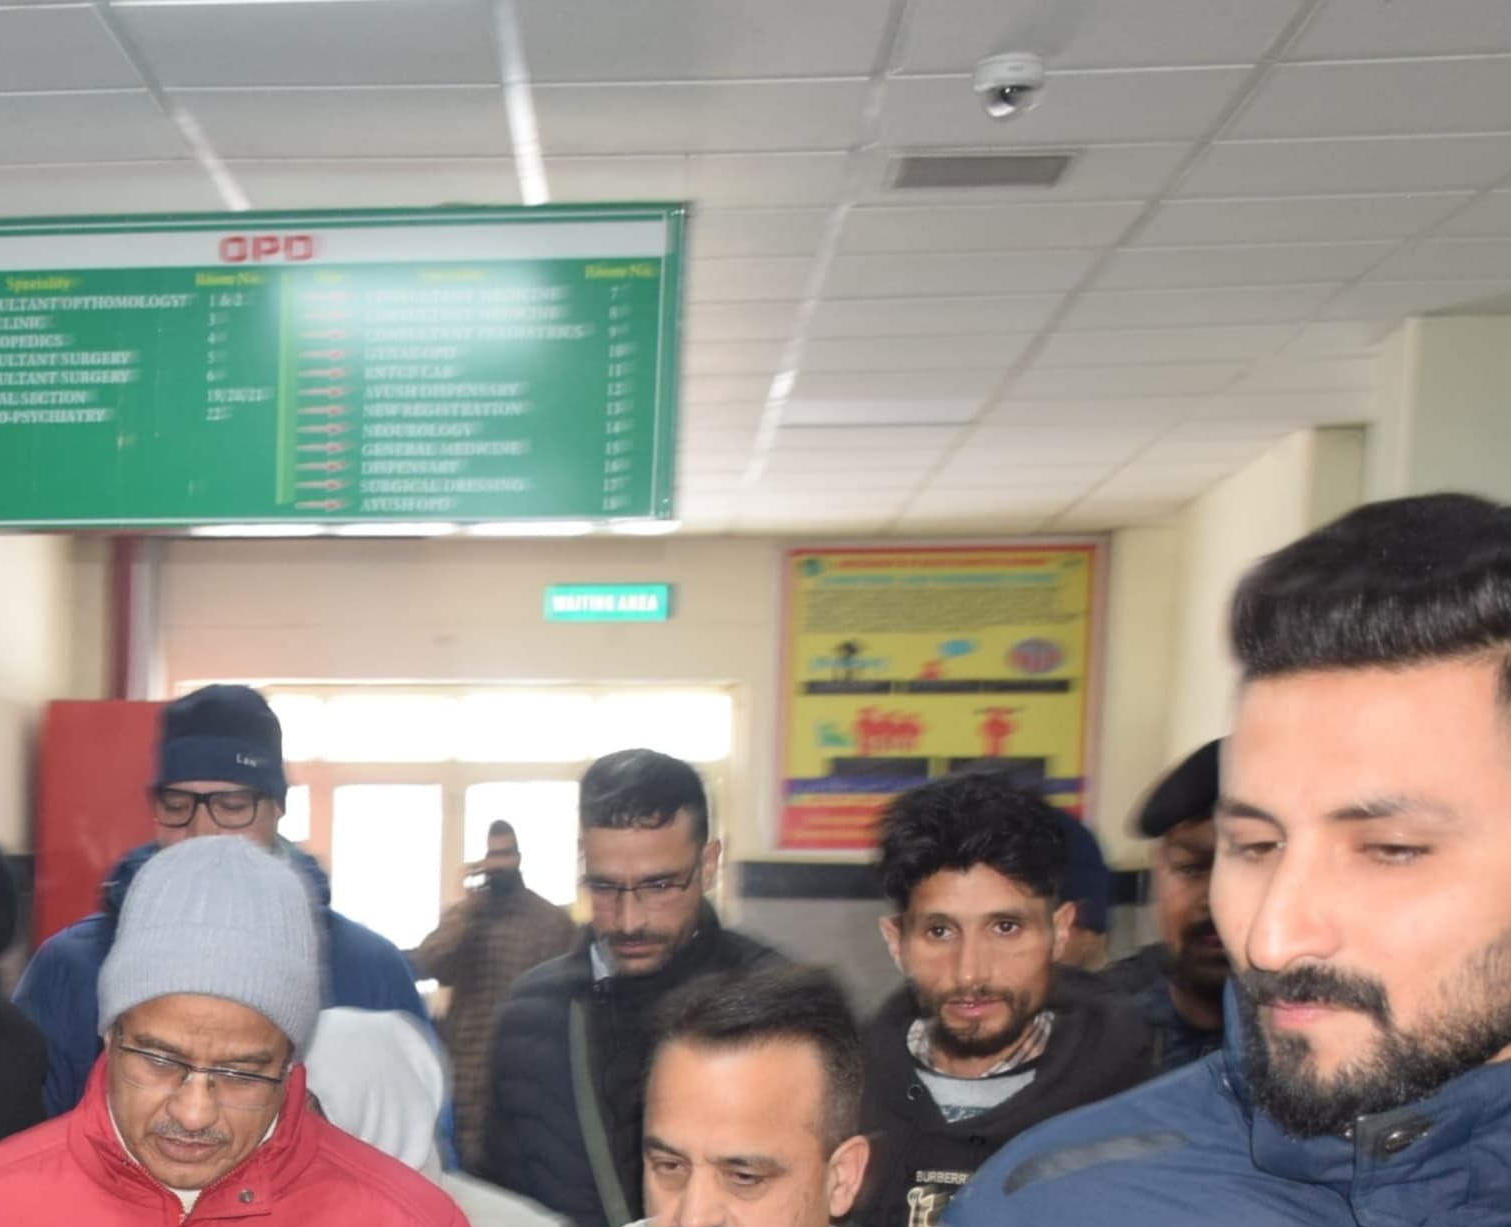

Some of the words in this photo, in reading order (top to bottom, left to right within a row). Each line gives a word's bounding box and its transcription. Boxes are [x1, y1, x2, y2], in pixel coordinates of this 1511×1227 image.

[220, 236, 314, 262] OPD
[60, 350, 132, 366] SURGERY
[60, 369, 131, 384] SURGERY
[20, 389, 88, 404] SECTION
[402, 400, 524, 417] REGISTRATION
[361, 441, 438, 457] GENERAL
[440, 439, 526, 456] MEDICINE
[553, 594, 616, 613] WAITING
[617, 594, 659, 613] AREA
